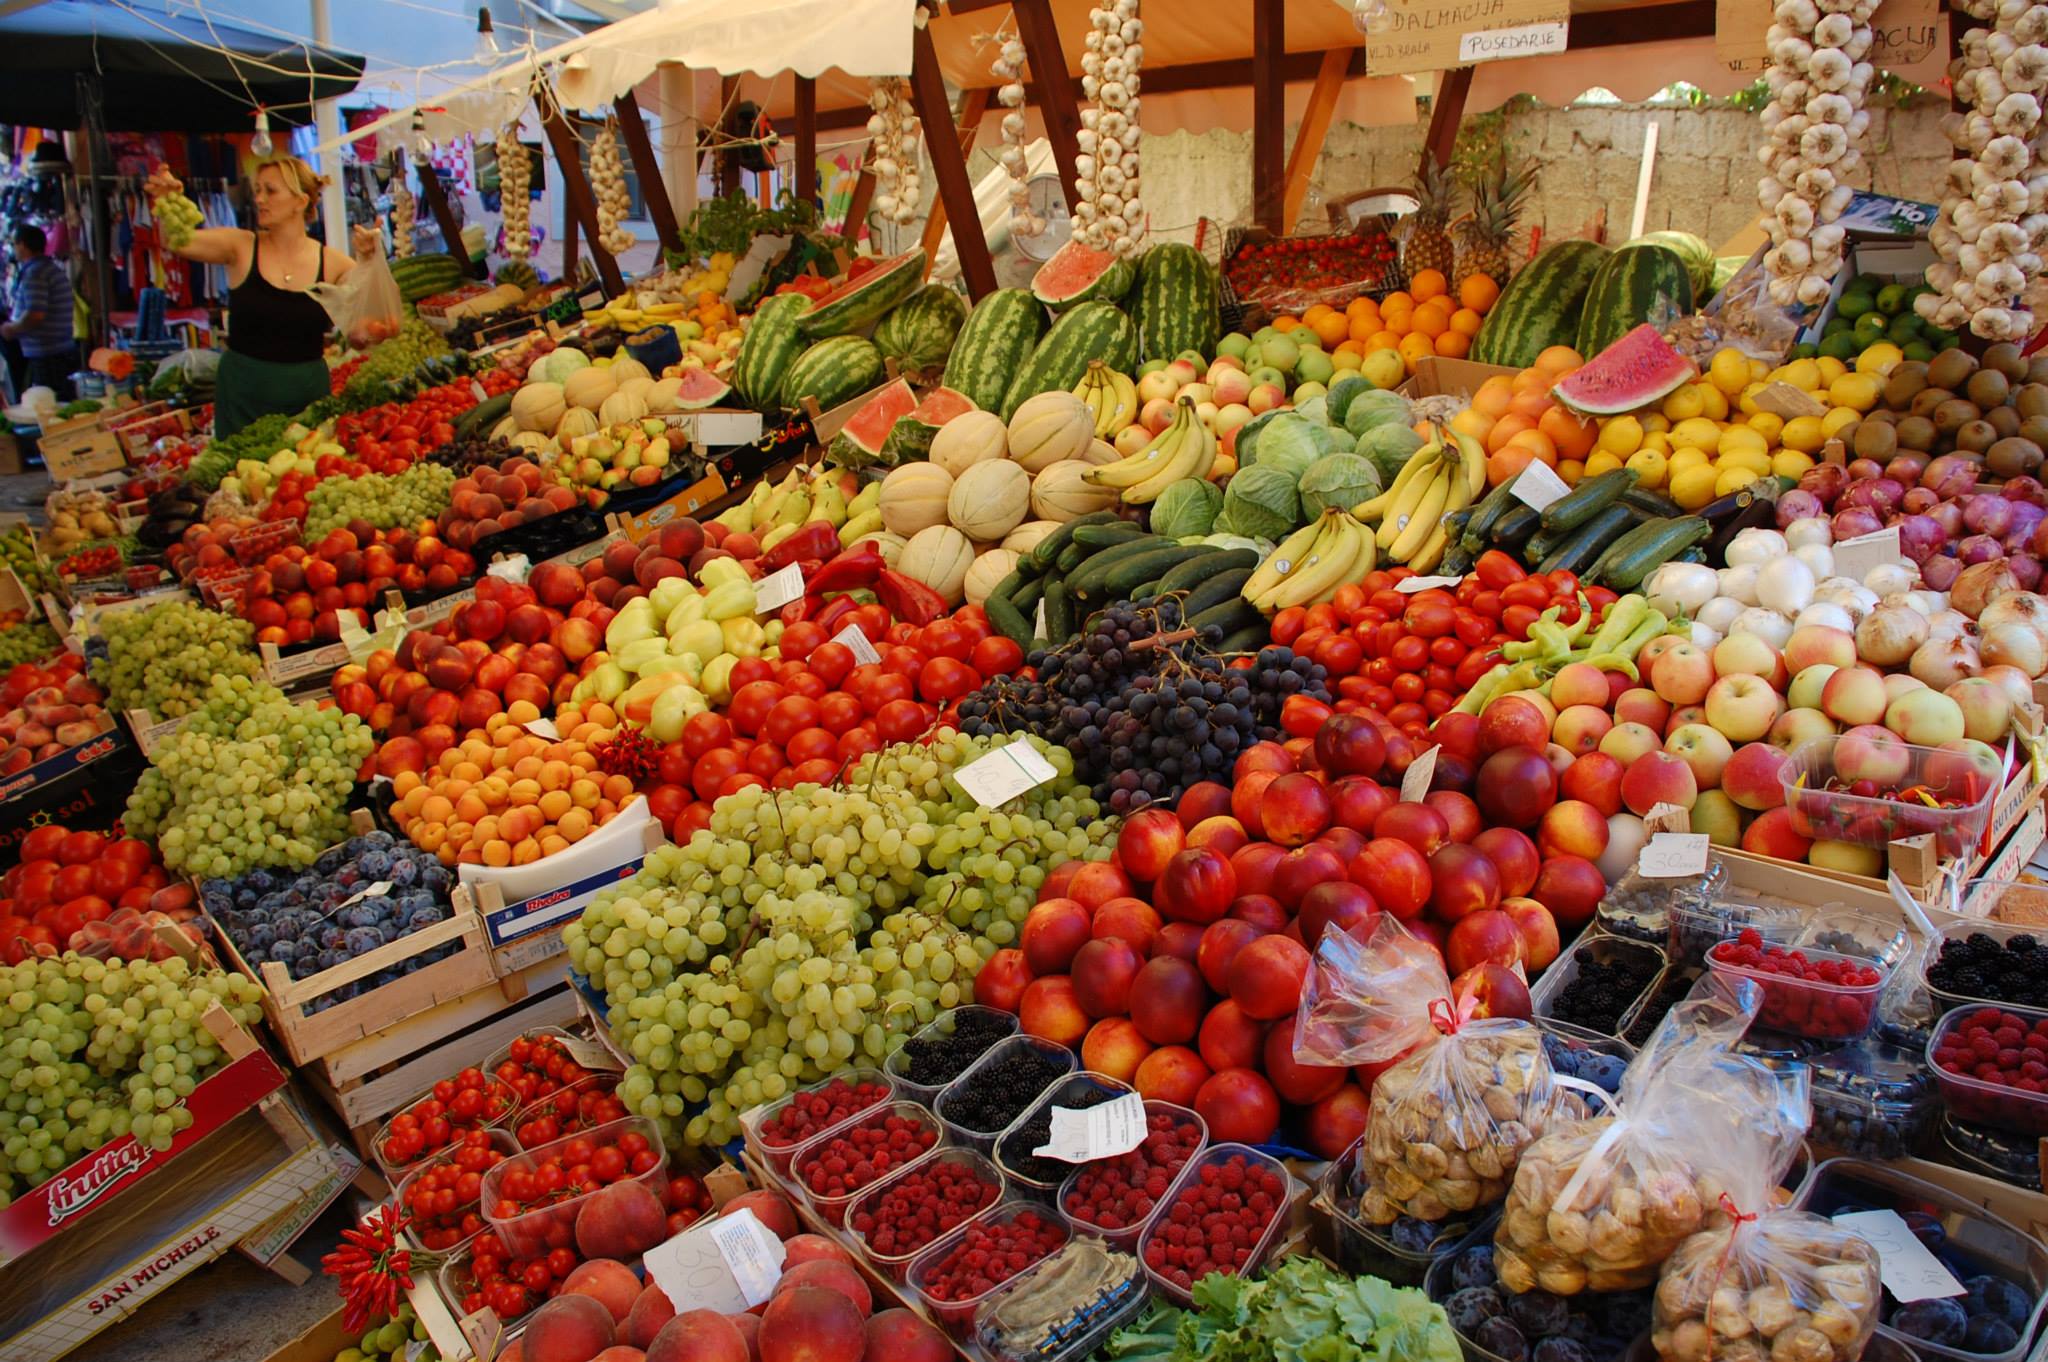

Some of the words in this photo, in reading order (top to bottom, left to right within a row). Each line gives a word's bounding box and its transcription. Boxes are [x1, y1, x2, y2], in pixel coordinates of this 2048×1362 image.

[299, 1176, 342, 1219] LIBORIO
[260, 1216, 301, 1257] FRUTTA
[87, 1280, 133, 1315] SAN
[131, 1226, 221, 1287] MICHELE
